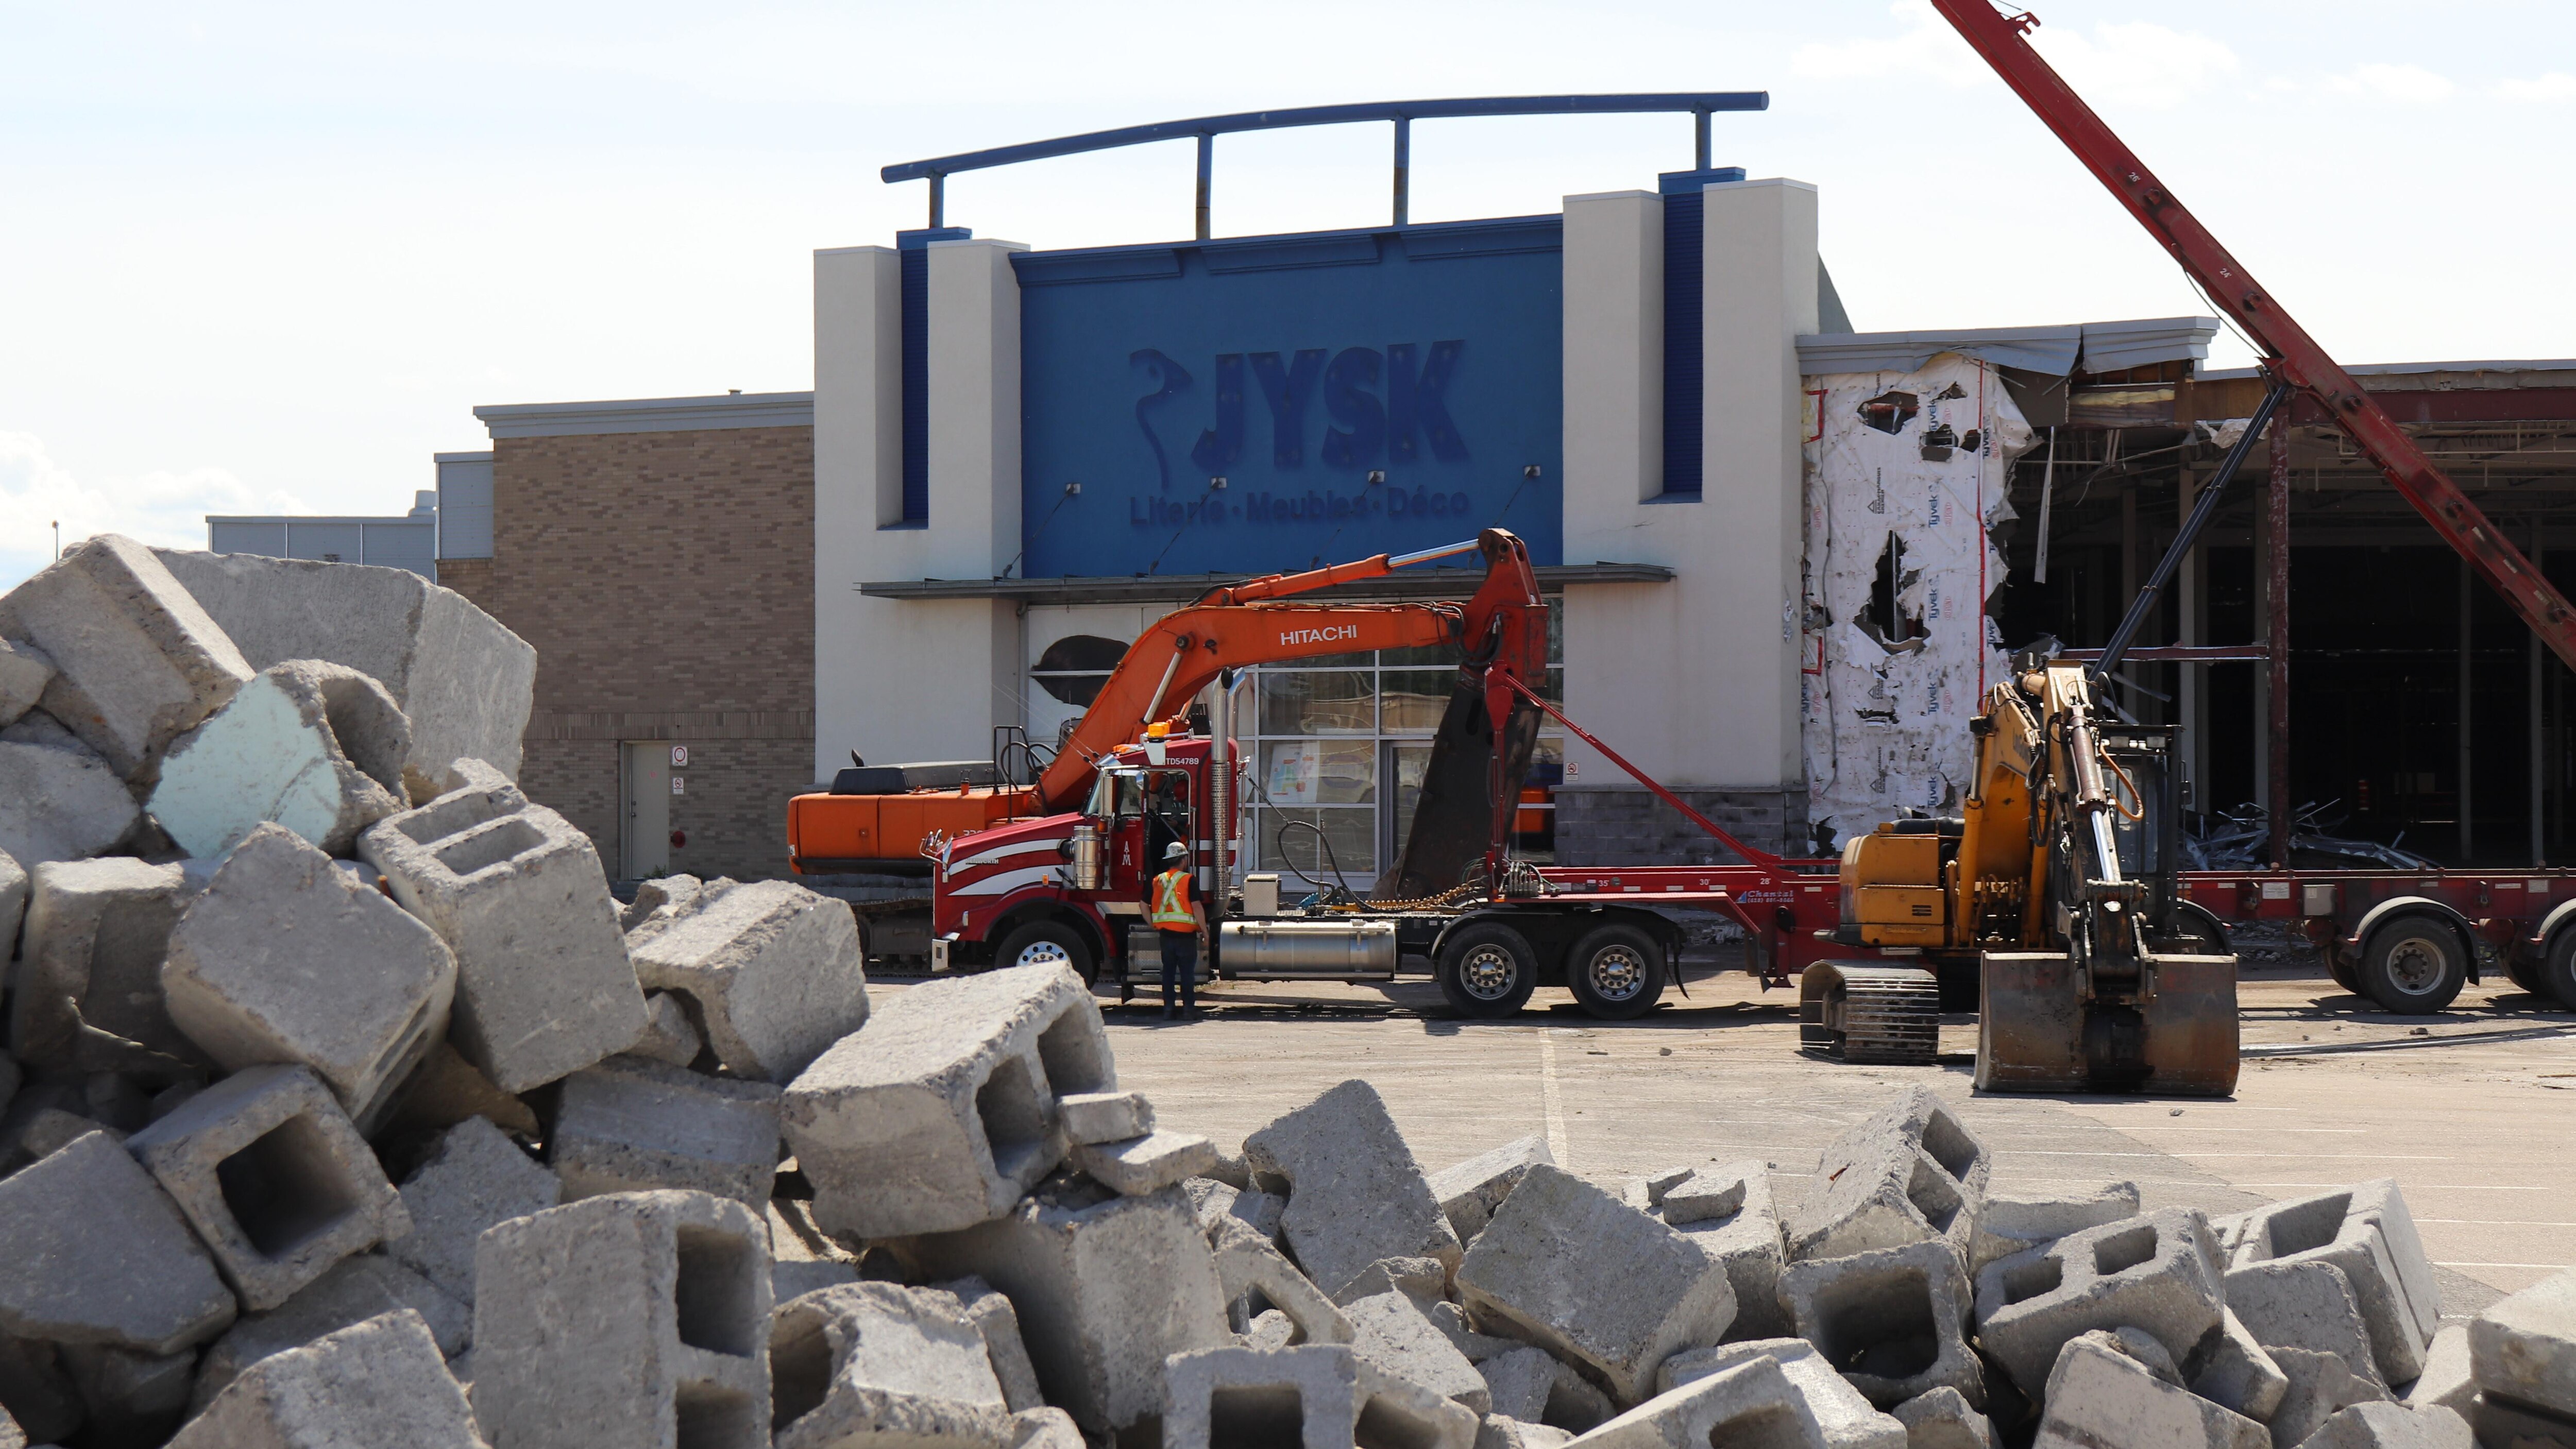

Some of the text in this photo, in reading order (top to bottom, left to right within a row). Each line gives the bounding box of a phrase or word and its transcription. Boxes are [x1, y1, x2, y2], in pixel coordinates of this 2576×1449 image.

[1191, 339, 1470, 470] JYSK
[1130, 484, 1470, 525] Literie Meubles Déco
[1928, 495, 1940, 528] Tyvek
[1928, 588, 1940, 622] Tyvek
[1280, 624, 1358, 646] HITACHI
[1927, 683, 1939, 715] Tyvek
[1928, 776, 1939, 809] Tyvek
